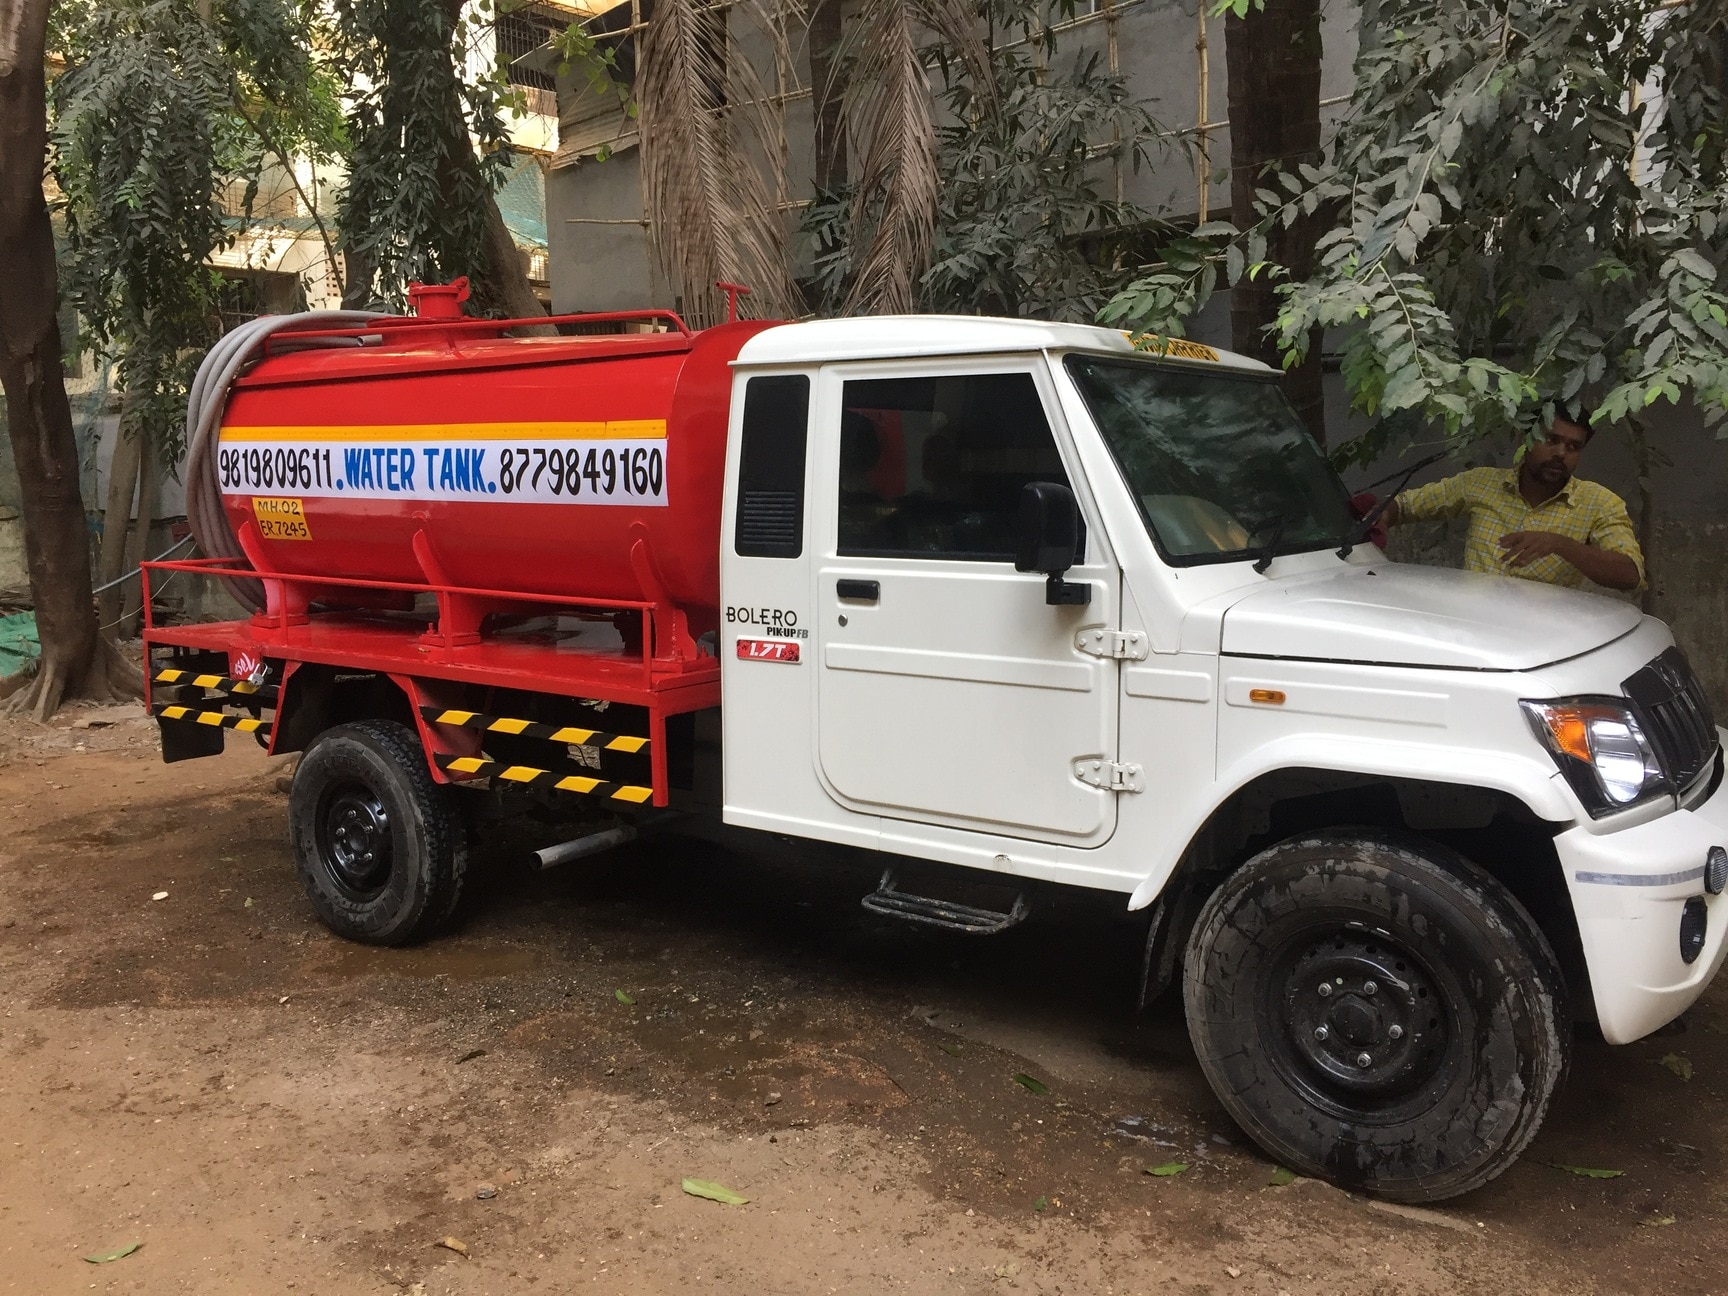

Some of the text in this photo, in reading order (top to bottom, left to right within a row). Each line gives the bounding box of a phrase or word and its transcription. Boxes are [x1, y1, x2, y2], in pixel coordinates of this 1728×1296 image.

[220, 448, 332, 490] 9819809611
[500, 447, 663, 496] 8779849160
[726, 607, 798, 626] BOLERO
[750, 643, 786, 658] 1.7T
